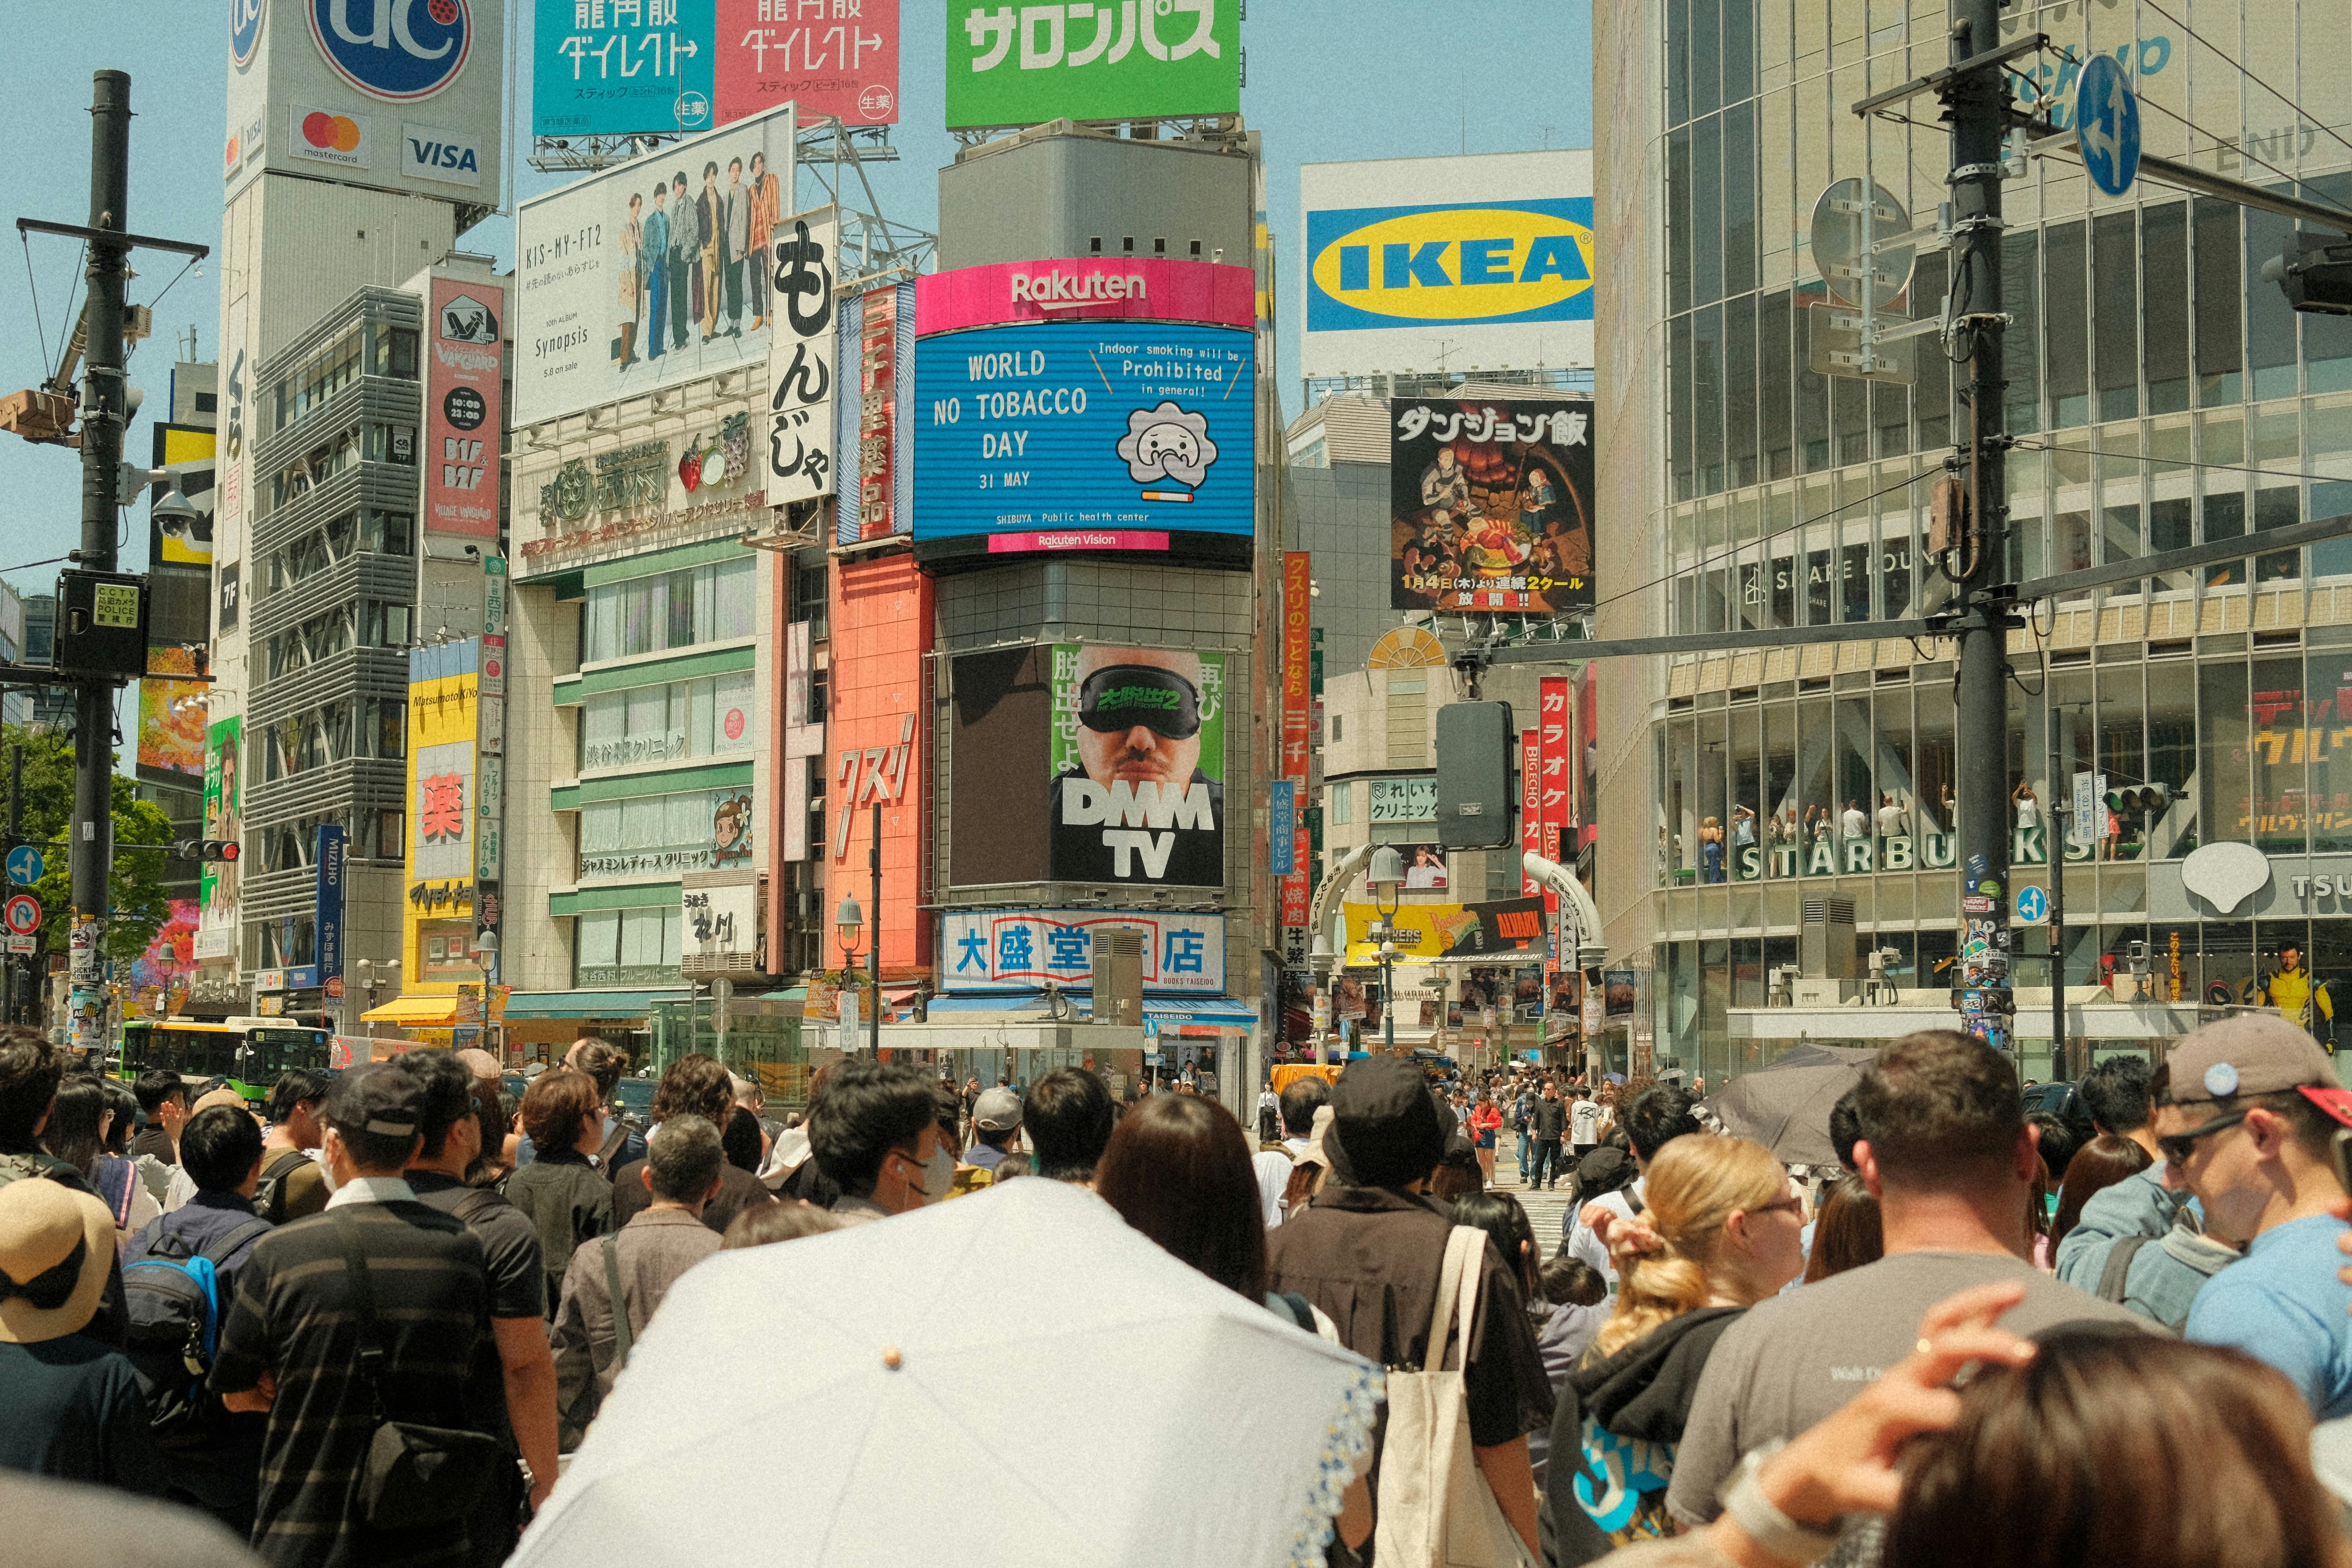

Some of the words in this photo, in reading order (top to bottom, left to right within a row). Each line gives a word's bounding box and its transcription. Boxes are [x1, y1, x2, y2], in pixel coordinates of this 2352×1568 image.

[740, 26, 883, 72] ダイレクト
[965, 0, 1220, 73] サロンパス
[558, 33, 698, 79] ダイレクト
[575, 87, 628, 100] スティック
[632, 88, 654, 96] ミント
[757, 81, 811, 93] スティック
[815, 81, 839, 90] ピーチ
[677, 100, 705, 117] 生薬
[861, 94, 890, 111] 生薬
[246, 117, 262, 146] VISA
[541, 116, 590, 128] 第3類医薬品
[304, 149, 357, 164] mastercard
[407, 138, 477, 173] VISA
[526, 224, 601, 270] KIS-MY-FT2
[1340, 235, 1591, 291] IKEA
[1011, 270, 1146, 303] Rakuten
[547, 318, 557, 328] 10th
[559, 312, 578, 324] ALBUM
[536, 325, 588, 359] Synopsis
[1098, 342, 1139, 355] Indoor
[1147, 344, 1193, 359] smoking
[1199, 347, 1221, 360] will
[1227, 350, 1239, 362] be
[544, 368, 554, 378] 5.8
[555, 366, 563, 375] on
[565, 361, 578, 371] sale
[771, 221, 832, 491] もんじゃ
[968, 350, 1045, 382] WORLD
[1123, 360, 1222, 382] Prohibited
[452, 398, 481, 409] 10:00
[1142, 384, 1153, 395] in
[1159, 385, 1205, 398] general!
[451, 408, 480, 420] 23:00
[859, 294, 888, 526] 三千里薬品
[934, 398, 960, 426] NO
[976, 387, 1087, 420] TOBACCO
[1398, 406, 1588, 446] ダンジョン飯
[445, 437, 484, 462] B1F
[983, 430, 1028, 459] DAY
[443, 465, 485, 490] B2F
[594, 460, 665, 514] 西村
[979, 474, 994, 490] 31
[1004, 471, 1030, 487] MAY
[435, 502, 457, 517] VILLAGE
[460, 506, 491, 521] VANGUARD
[651, 497, 744, 529] シルバーアクセサリー
[996, 513, 1032, 525] SHIBUYA
[1042, 512, 1074, 523] Public
[1079, 511, 1112, 522] health
[1117, 513, 1149, 522] center
[1039, 534, 1081, 546] Rakuten
[1083, 534, 1115, 545] Vision
[99, 587, 135, 597] CCTV
[223, 581, 237, 609] 7F
[1402, 575, 1584, 591] 1月4日(木)より連続2クール
[98, 596, 135, 606] 防犯カメラ
[98, 605, 135, 615] POLICE
[488, 596, 501, 623] 西村
[1809, 596, 1827, 608] SHARE
[98, 614, 134, 624] 警視庁
[1289, 559, 1305, 696] クスリのことなら
[413, 692, 458, 708] Matsumoto
[1098, 685, 1183, 711] 大脱出2
[1134, 701, 1163, 709] ESCAPE
[1195, 663, 1223, 721] 再び
[1054, 651, 1082, 772] 脱出せよ
[586, 743, 612, 765] 渋谷
[613, 741, 631, 750] 美容
[613, 750, 631, 761] 外科
[632, 734, 685, 758] クリニック
[732, 741, 753, 750] クリニック
[1525, 746, 1538, 771] BIG
[1542, 693, 1566, 808] カラオケ
[1528, 772, 1539, 809] ECHO
[422, 772, 464, 837] 薬
[1062, 778, 1215, 831] DMM
[2081, 779, 2091, 839] 渋谷駅前
[1276, 786, 1289, 869] 大盛堂商事ビル
[329, 838, 339, 887] MIZUHO
[1102, 829, 1176, 878] TV
[1743, 827, 2092, 879] STARBUKS
[481, 894, 498, 925] HUB
[1311, 865, 1341, 932] 渋谷センター街
[1551, 875, 1587, 937] 渋谷センター街
[323, 922, 334, 973] みずほ銀行
[956, 925, 1205, 974] 大盛堂店
[1287, 927, 1304, 964] 牛繁
[582, 969, 616, 981] 渋谷西村
[1163, 977, 1184, 986] BOOKS
[1186, 977, 1214, 986] TAISEIDO
[843, 998, 851, 1042] 文化村通り
